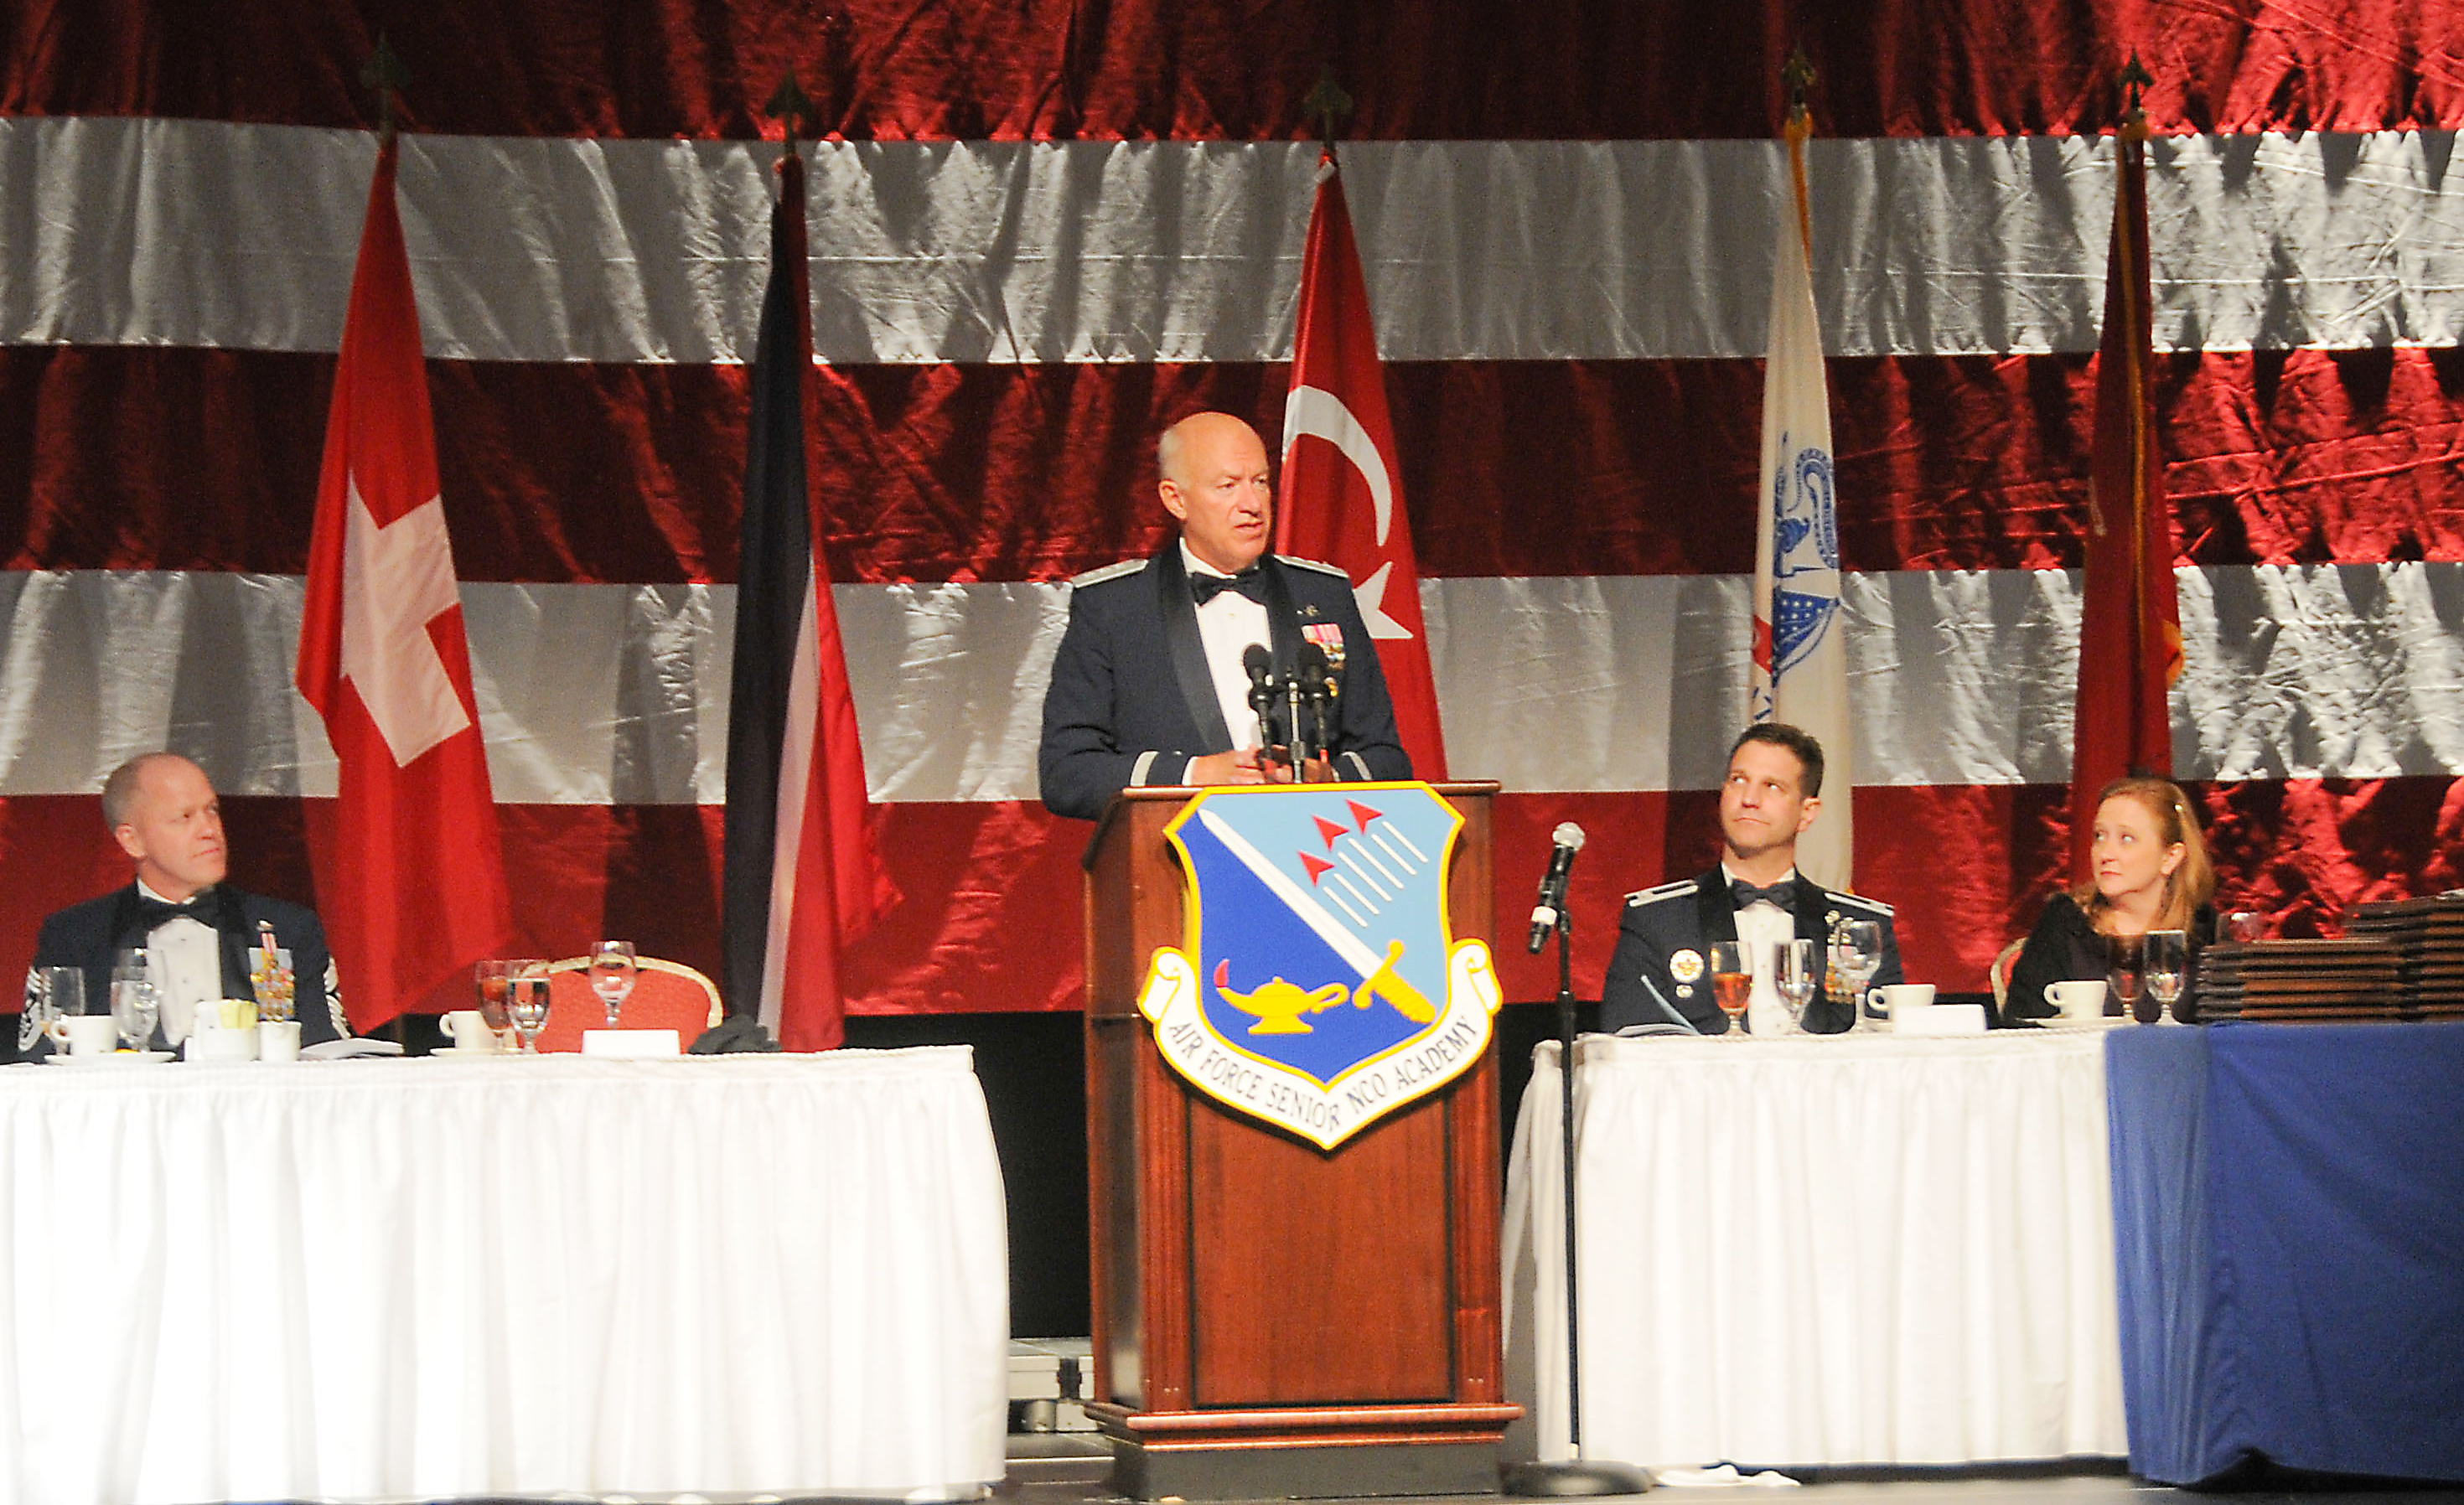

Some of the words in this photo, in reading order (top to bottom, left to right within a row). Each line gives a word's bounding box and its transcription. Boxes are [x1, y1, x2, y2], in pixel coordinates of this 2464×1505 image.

[1169, 1021, 1202, 1059] AIR
[1199, 1050, 1264, 1099] FORCE
[1266, 1082, 1340, 1132] SENIOR
[1346, 1073, 1387, 1115] NCO
[1395, 1015, 1478, 1089] ACADEMY
